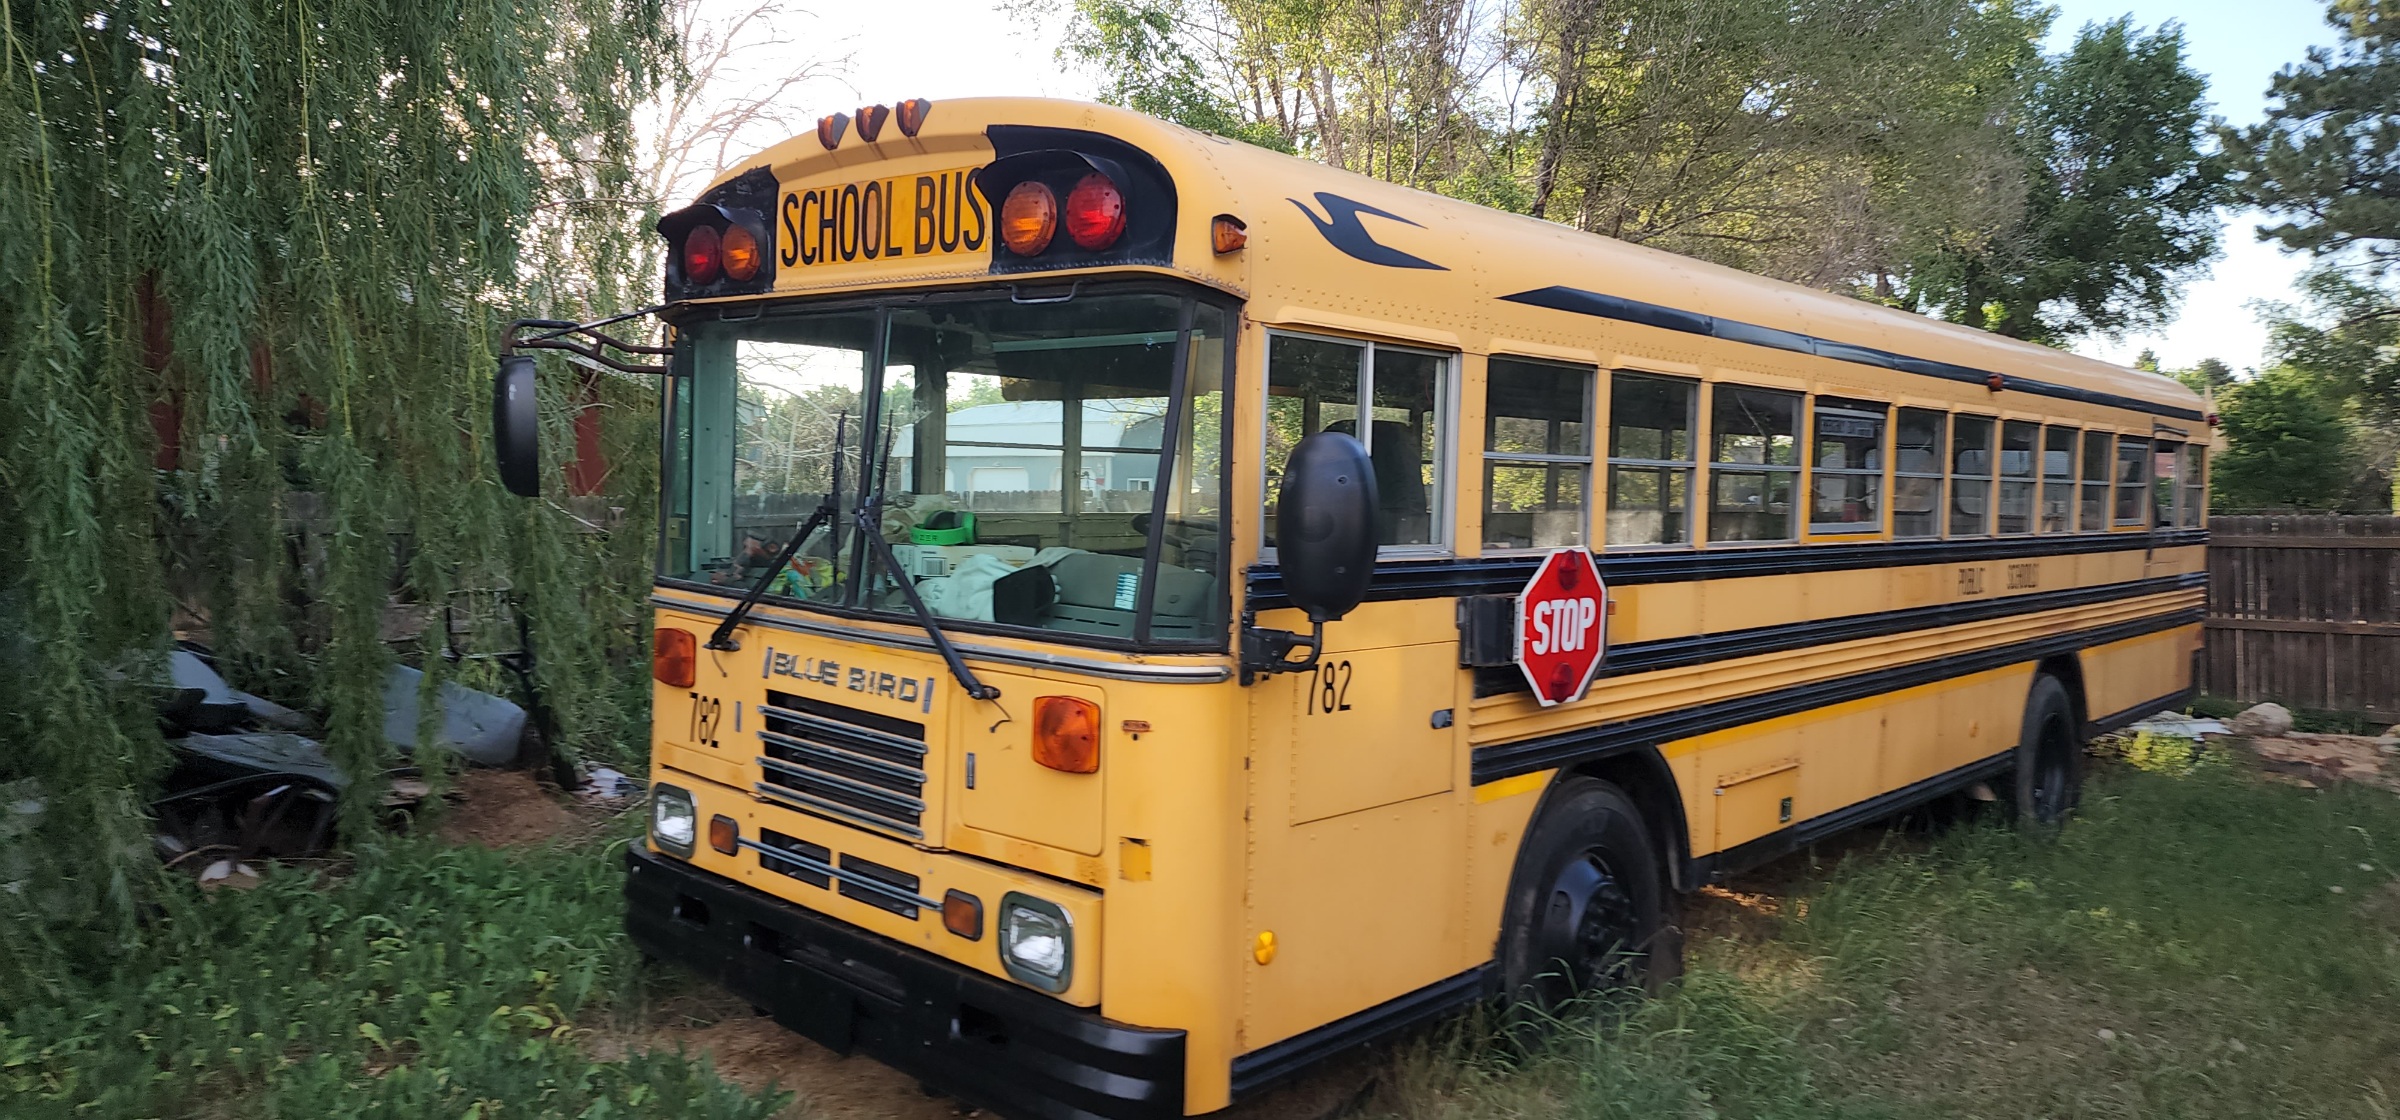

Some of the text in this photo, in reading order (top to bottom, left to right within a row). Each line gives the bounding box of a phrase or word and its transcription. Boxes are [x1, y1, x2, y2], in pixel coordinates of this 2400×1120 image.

[781, 167, 986, 267] SCHOOL BUS
[1531, 597, 1597, 656] STOP
[774, 652, 919, 703] BLUE BIRD
[1307, 660, 1352, 715] 782
[688, 691, 721, 749] 782
